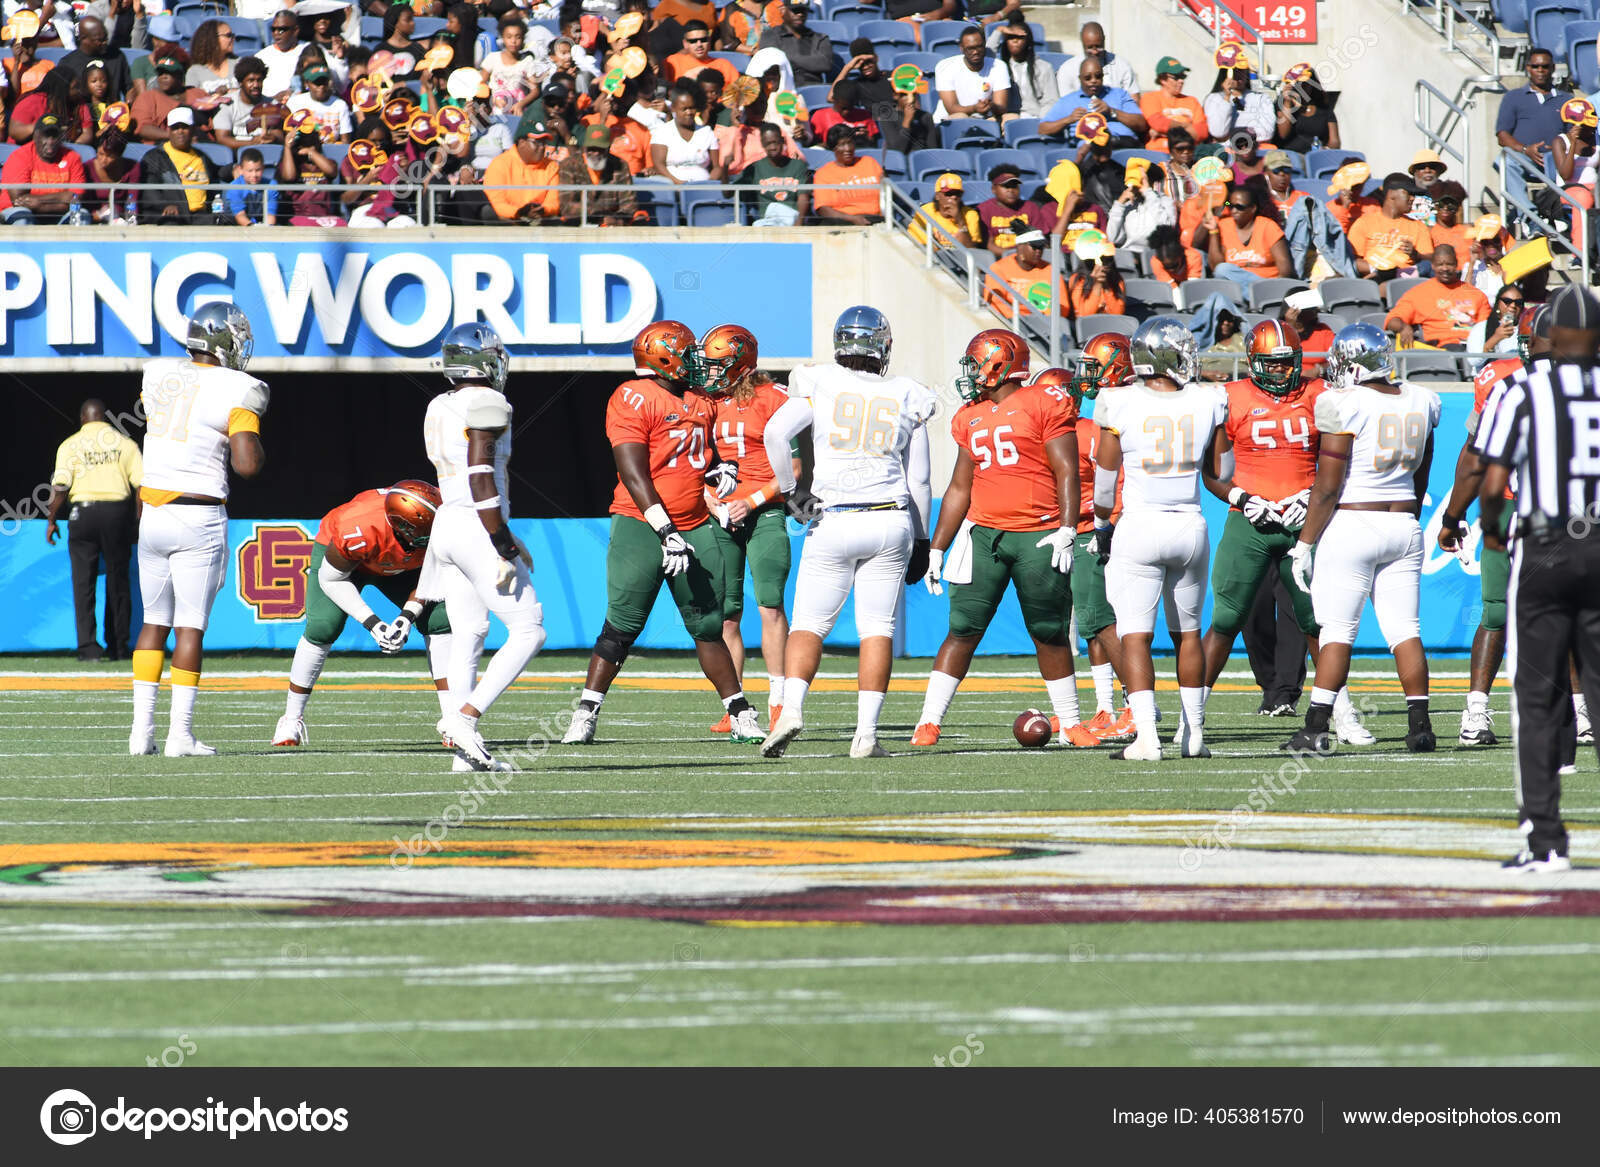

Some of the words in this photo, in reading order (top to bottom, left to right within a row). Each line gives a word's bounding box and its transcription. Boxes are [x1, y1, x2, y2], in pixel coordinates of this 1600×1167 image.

[1255, 6, 1306, 26] 149
[1283, 29, 1306, 38] 1-18
[0, 251, 236, 347] PING
[250, 251, 658, 348] WORLD
[829, 391, 900, 458] 96
[1142, 413, 1196, 475] 31
[1251, 417, 1310, 451] 54
[1373, 412, 1426, 472] 99
[84, 449, 122, 465] SECURITY
[667, 427, 706, 470] 70
[971, 425, 1020, 471] 56
[343, 525, 367, 551] 71
